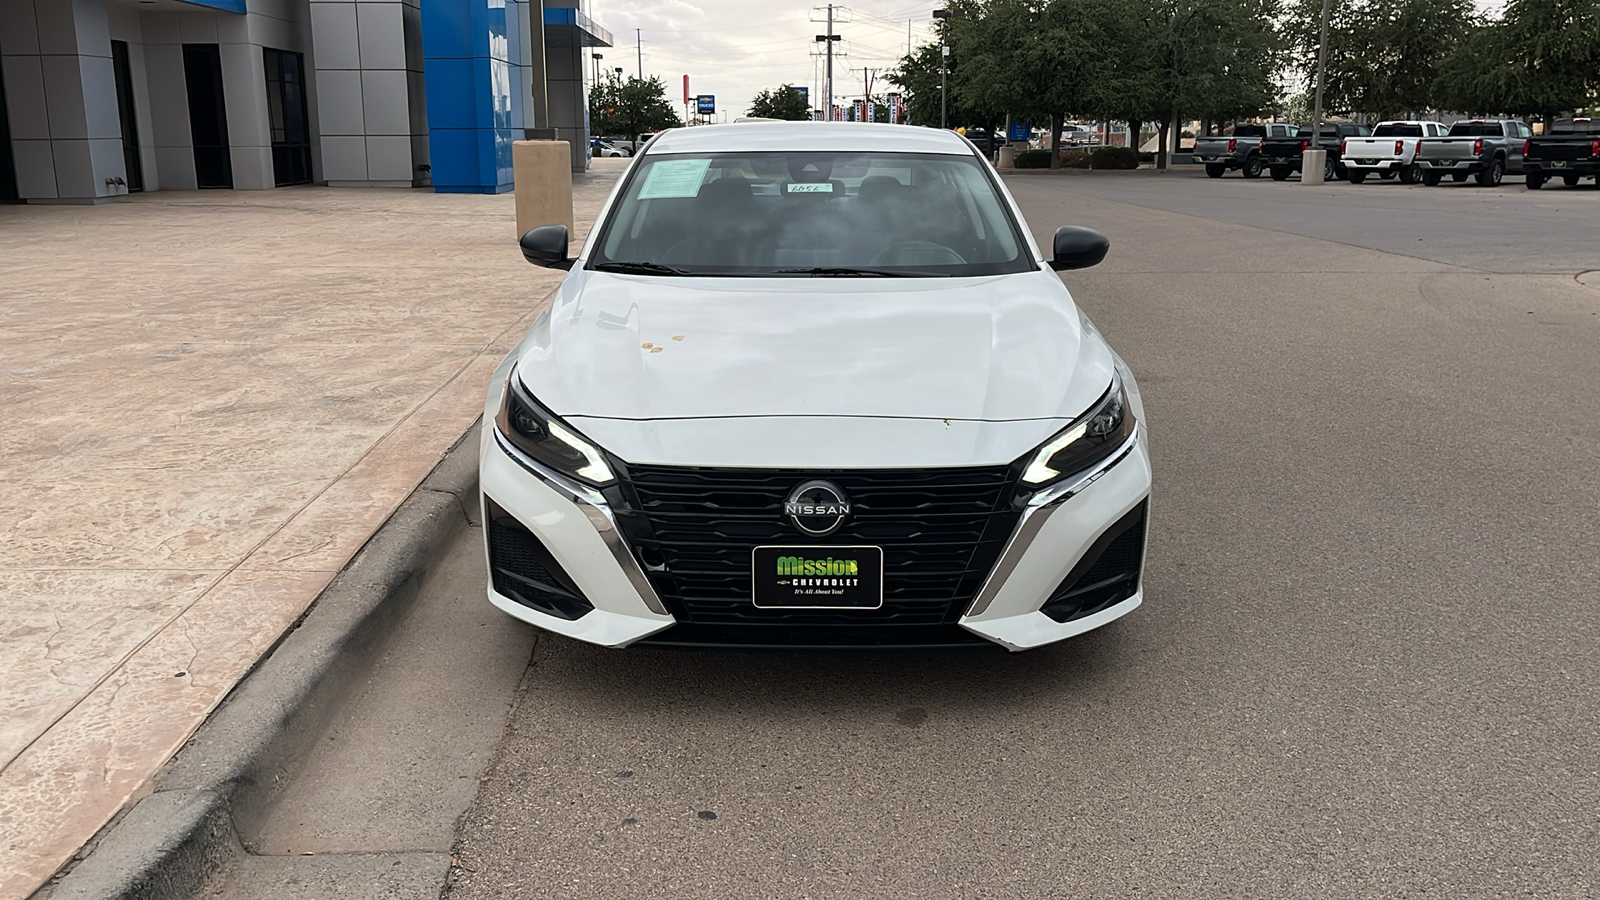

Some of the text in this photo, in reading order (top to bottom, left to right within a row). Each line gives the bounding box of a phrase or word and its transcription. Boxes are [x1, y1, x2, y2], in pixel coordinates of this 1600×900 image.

[786, 505, 849, 515] NISSAN
[777, 556, 858, 576] Mission
[792, 578, 858, 586] CHEVROLET
